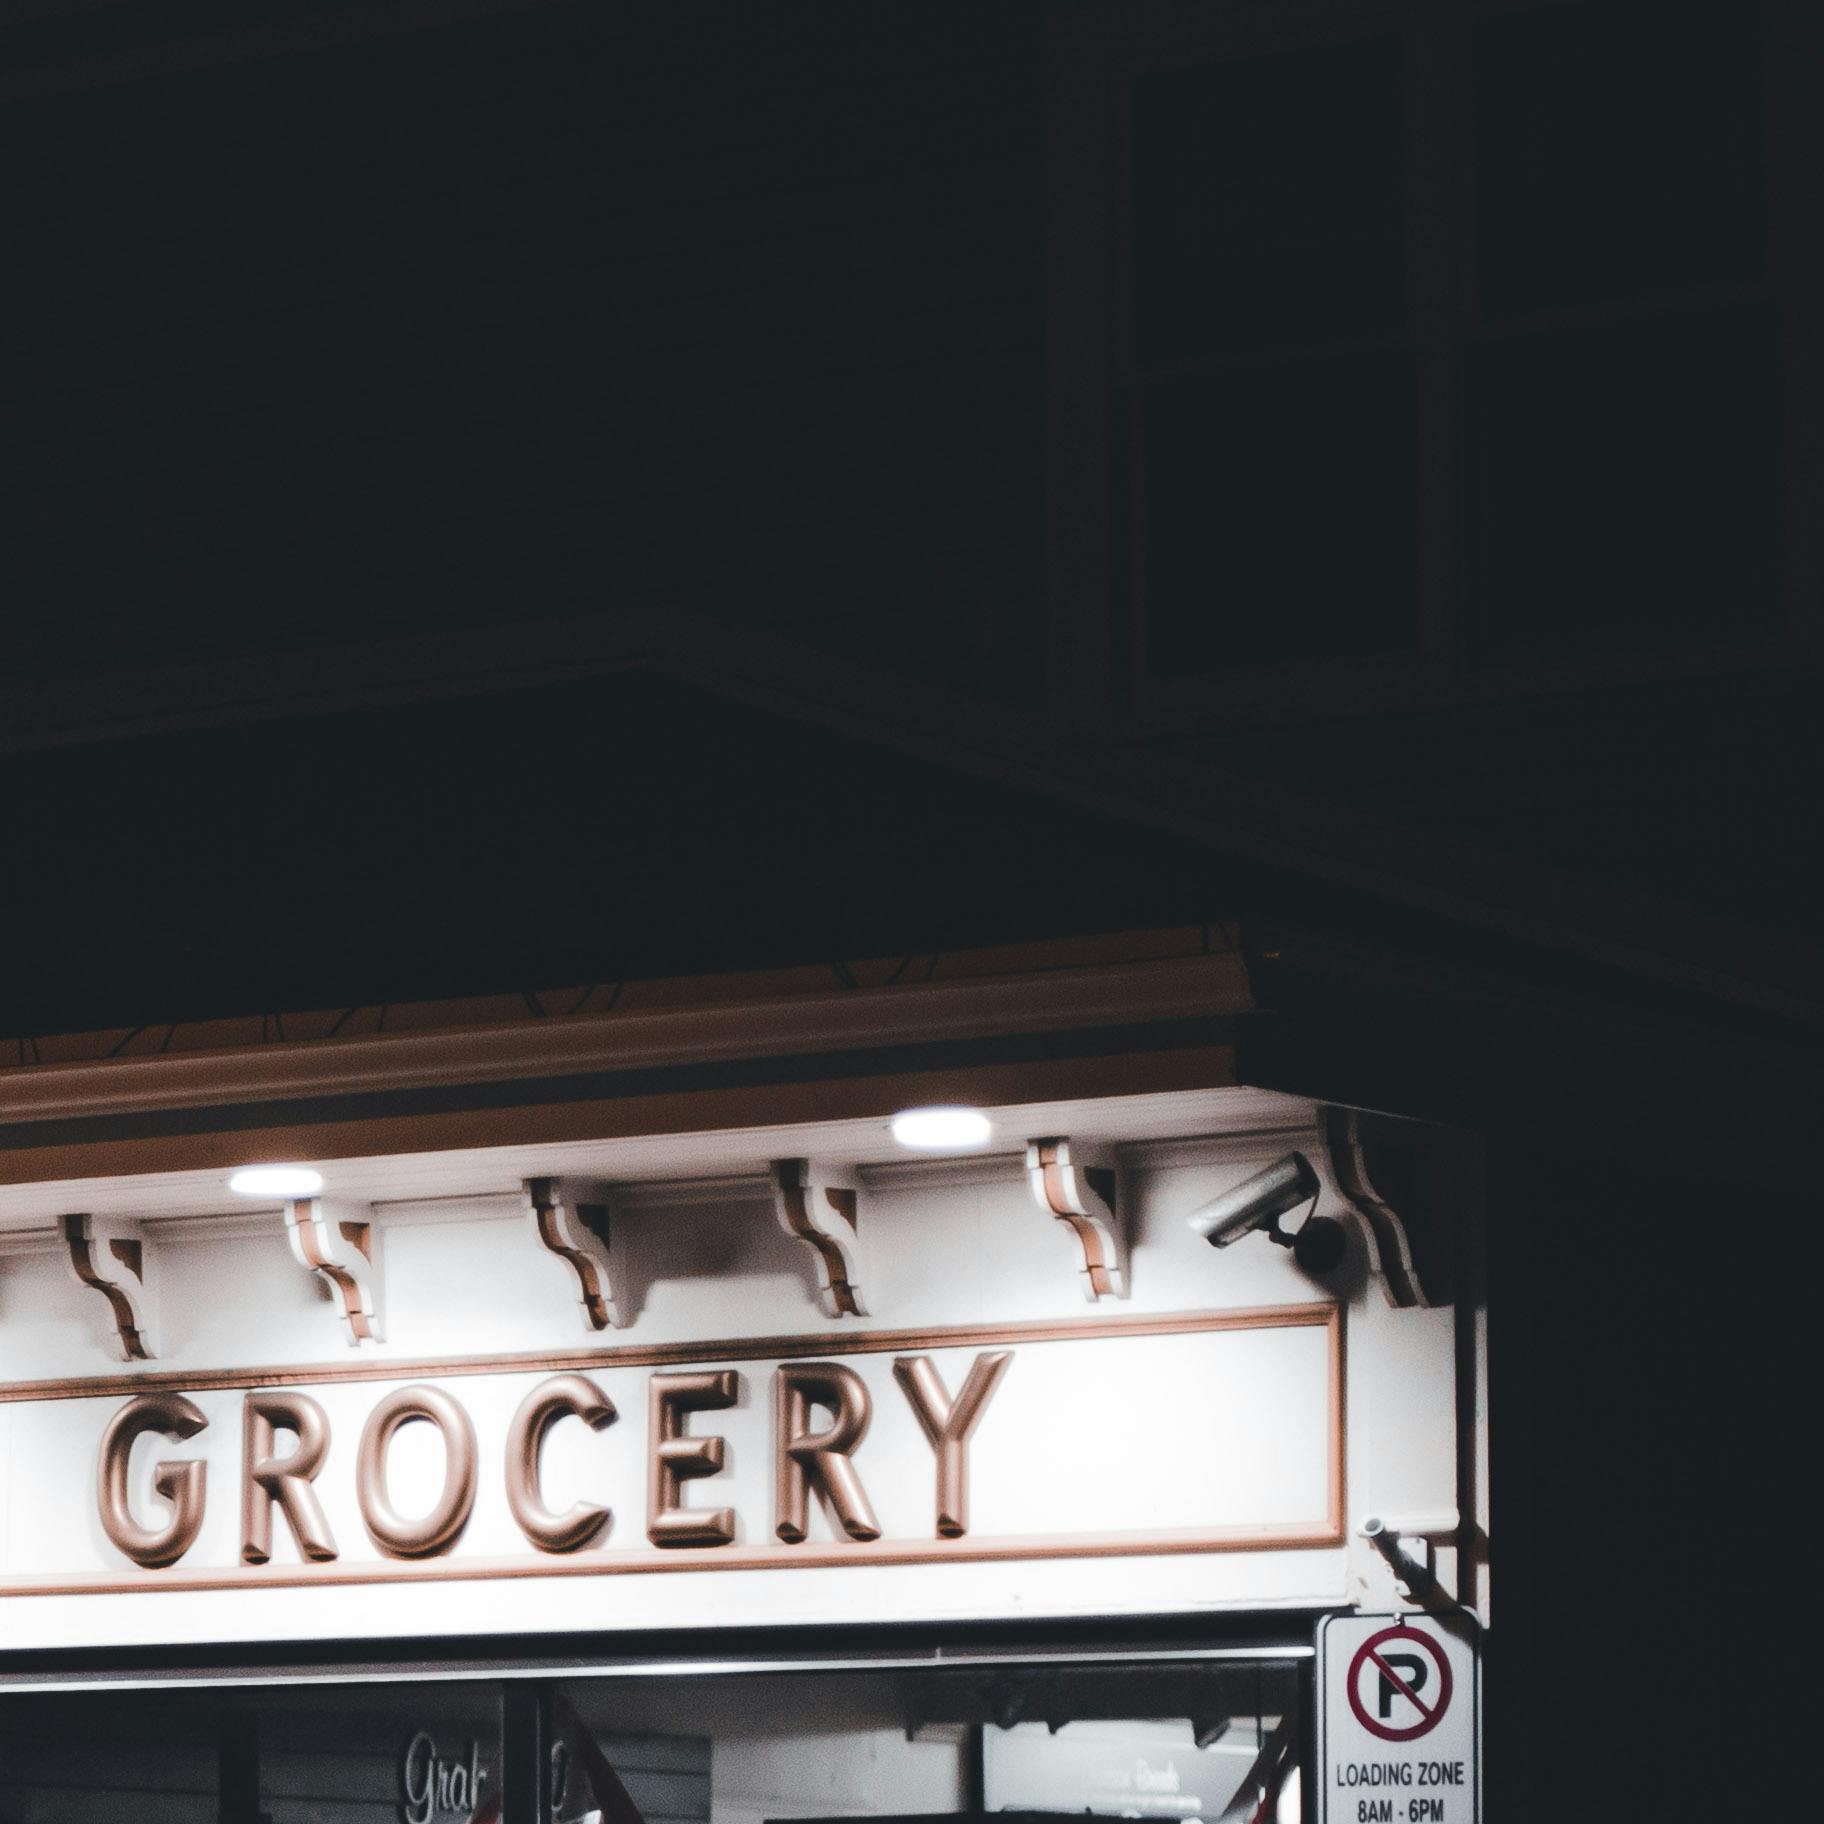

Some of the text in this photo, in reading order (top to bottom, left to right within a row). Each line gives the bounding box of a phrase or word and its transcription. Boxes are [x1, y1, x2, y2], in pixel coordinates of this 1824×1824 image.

[96, 1350, 1016, 1568] GROCERY
[1337, 1762, 1464, 1787] LOADING ZONE
[1358, 1800, 1393, 1823] 8AM
[1408, 1799, 1444, 1822] 6PM
